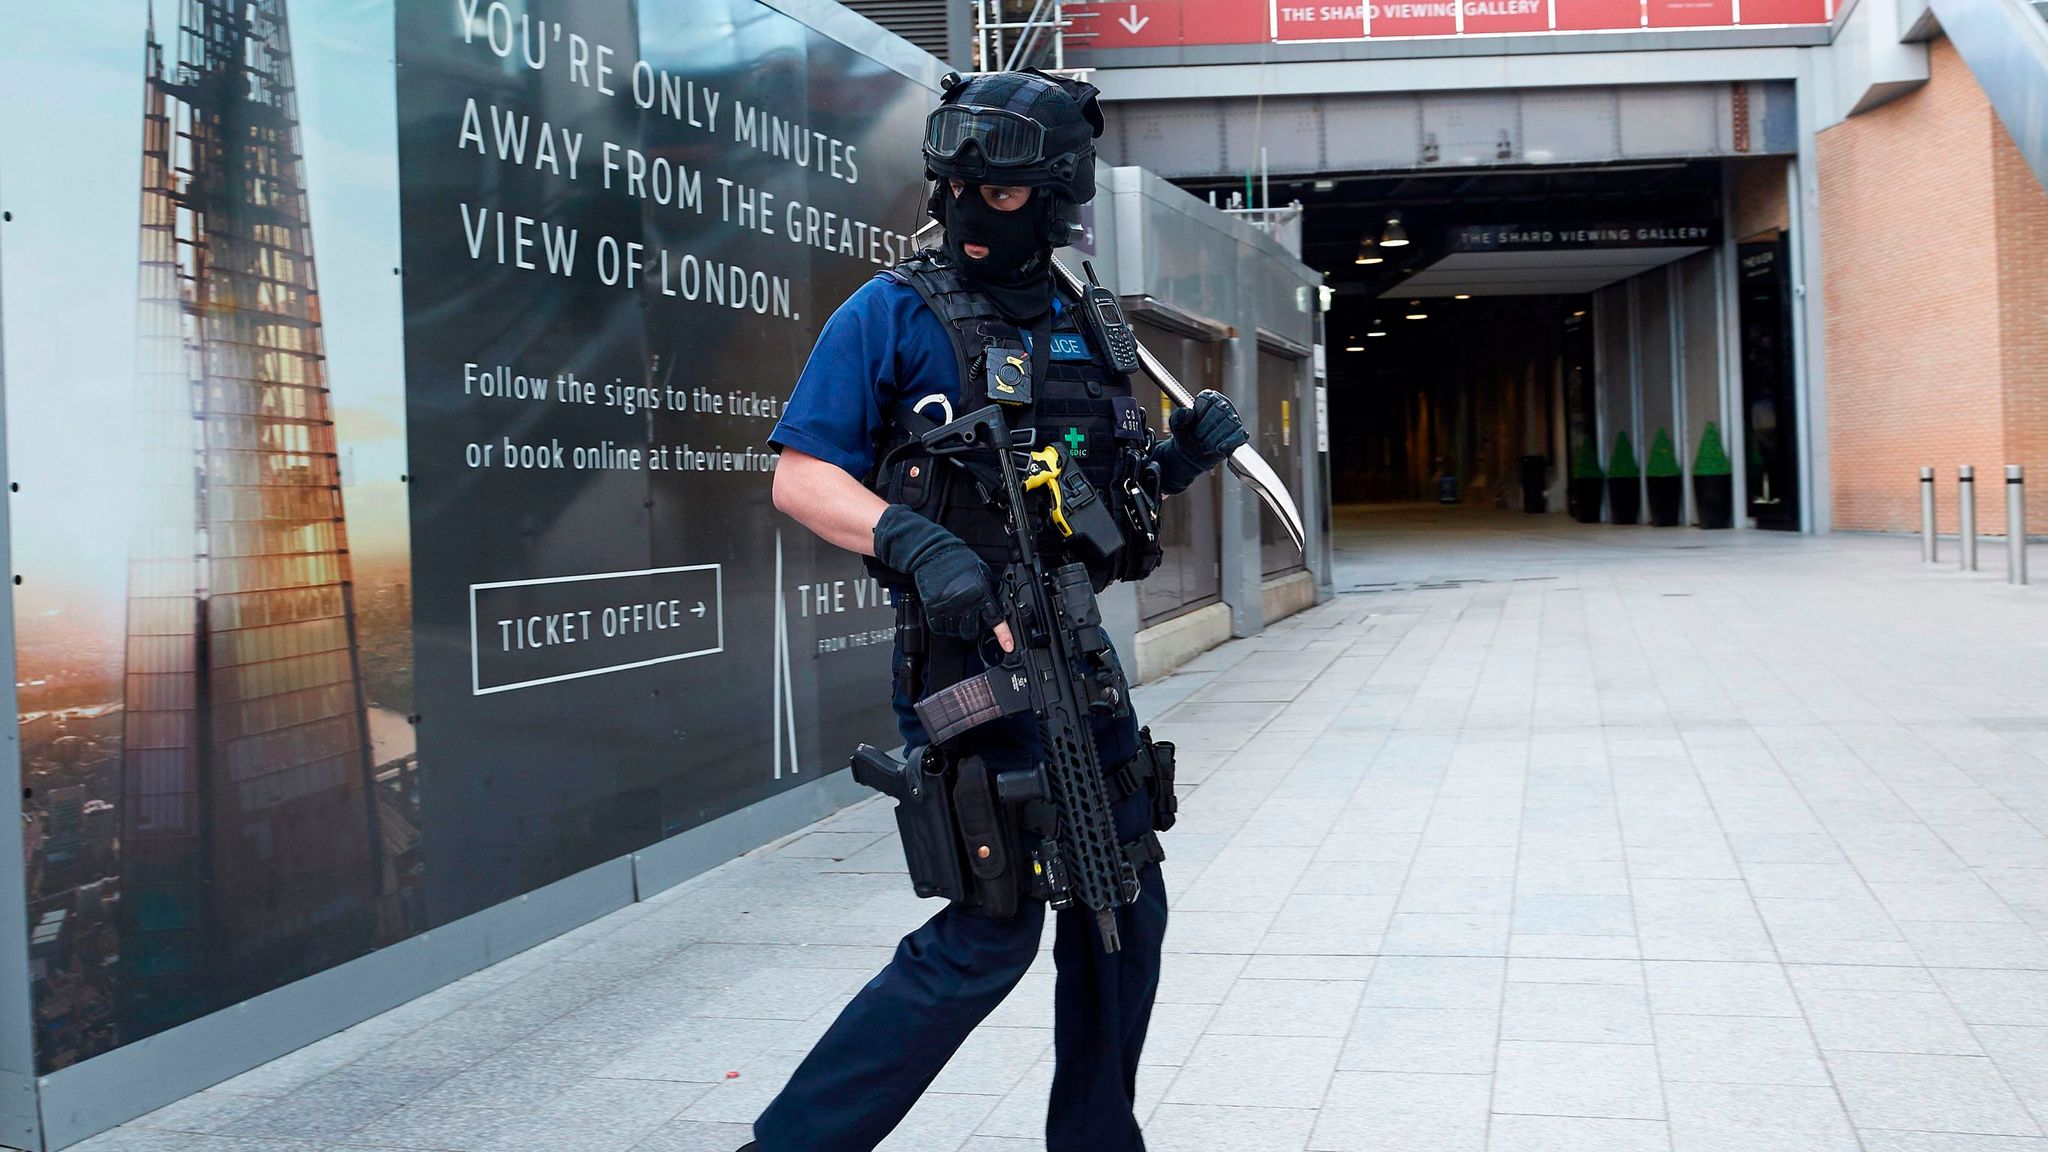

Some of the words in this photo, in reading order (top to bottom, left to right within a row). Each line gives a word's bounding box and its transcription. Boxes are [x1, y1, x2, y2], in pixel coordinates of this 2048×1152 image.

[1281, 7, 1315, 22] THE
[1384, 2, 1457, 19] VIEWING
[1464, 0, 1540, 17] GALLERY
[457, 0, 616, 97] YOU'RE
[632, 60, 720, 133] ONLY
[734, 101, 858, 184] MINUTES
[458, 98, 583, 180] AWAY
[604, 141, 703, 215] FROM
[717, 177, 775, 235] THE
[786, 200, 908, 268] GREATEST
[1461, 232, 1491, 244] THE
[1499, 231, 1553, 243] SHARD
[1559, 228, 1630, 242] VIEWING
[1637, 227, 1709, 240] GALLERY
[460, 203, 578, 277] VIEW
[597, 235, 644, 289] OF
[661, 249, 800, 321] LONDON.
[1028, 336, 1081, 354] LICE
[464, 362, 548, 400] Follow
[556, 373, 597, 405] the
[604, 377, 660, 415] signs
[666, 385, 687, 411] to
[693, 386, 723, 414] the
[728, 390, 778, 418] ticket
[466, 443, 494, 468] or
[503, 436, 565, 469] book
[573, 440, 641, 471] online
[649, 445, 669, 471] at
[1069, 449, 1087, 457] EDIC
[798, 581, 845, 617] THE
[854, 577, 892, 609] VIE
[498, 610, 592, 652] TICKET
[602, 600, 681, 638] OFFICE
[818, 636, 847, 654] FROM
[849, 632, 868, 648] THE
